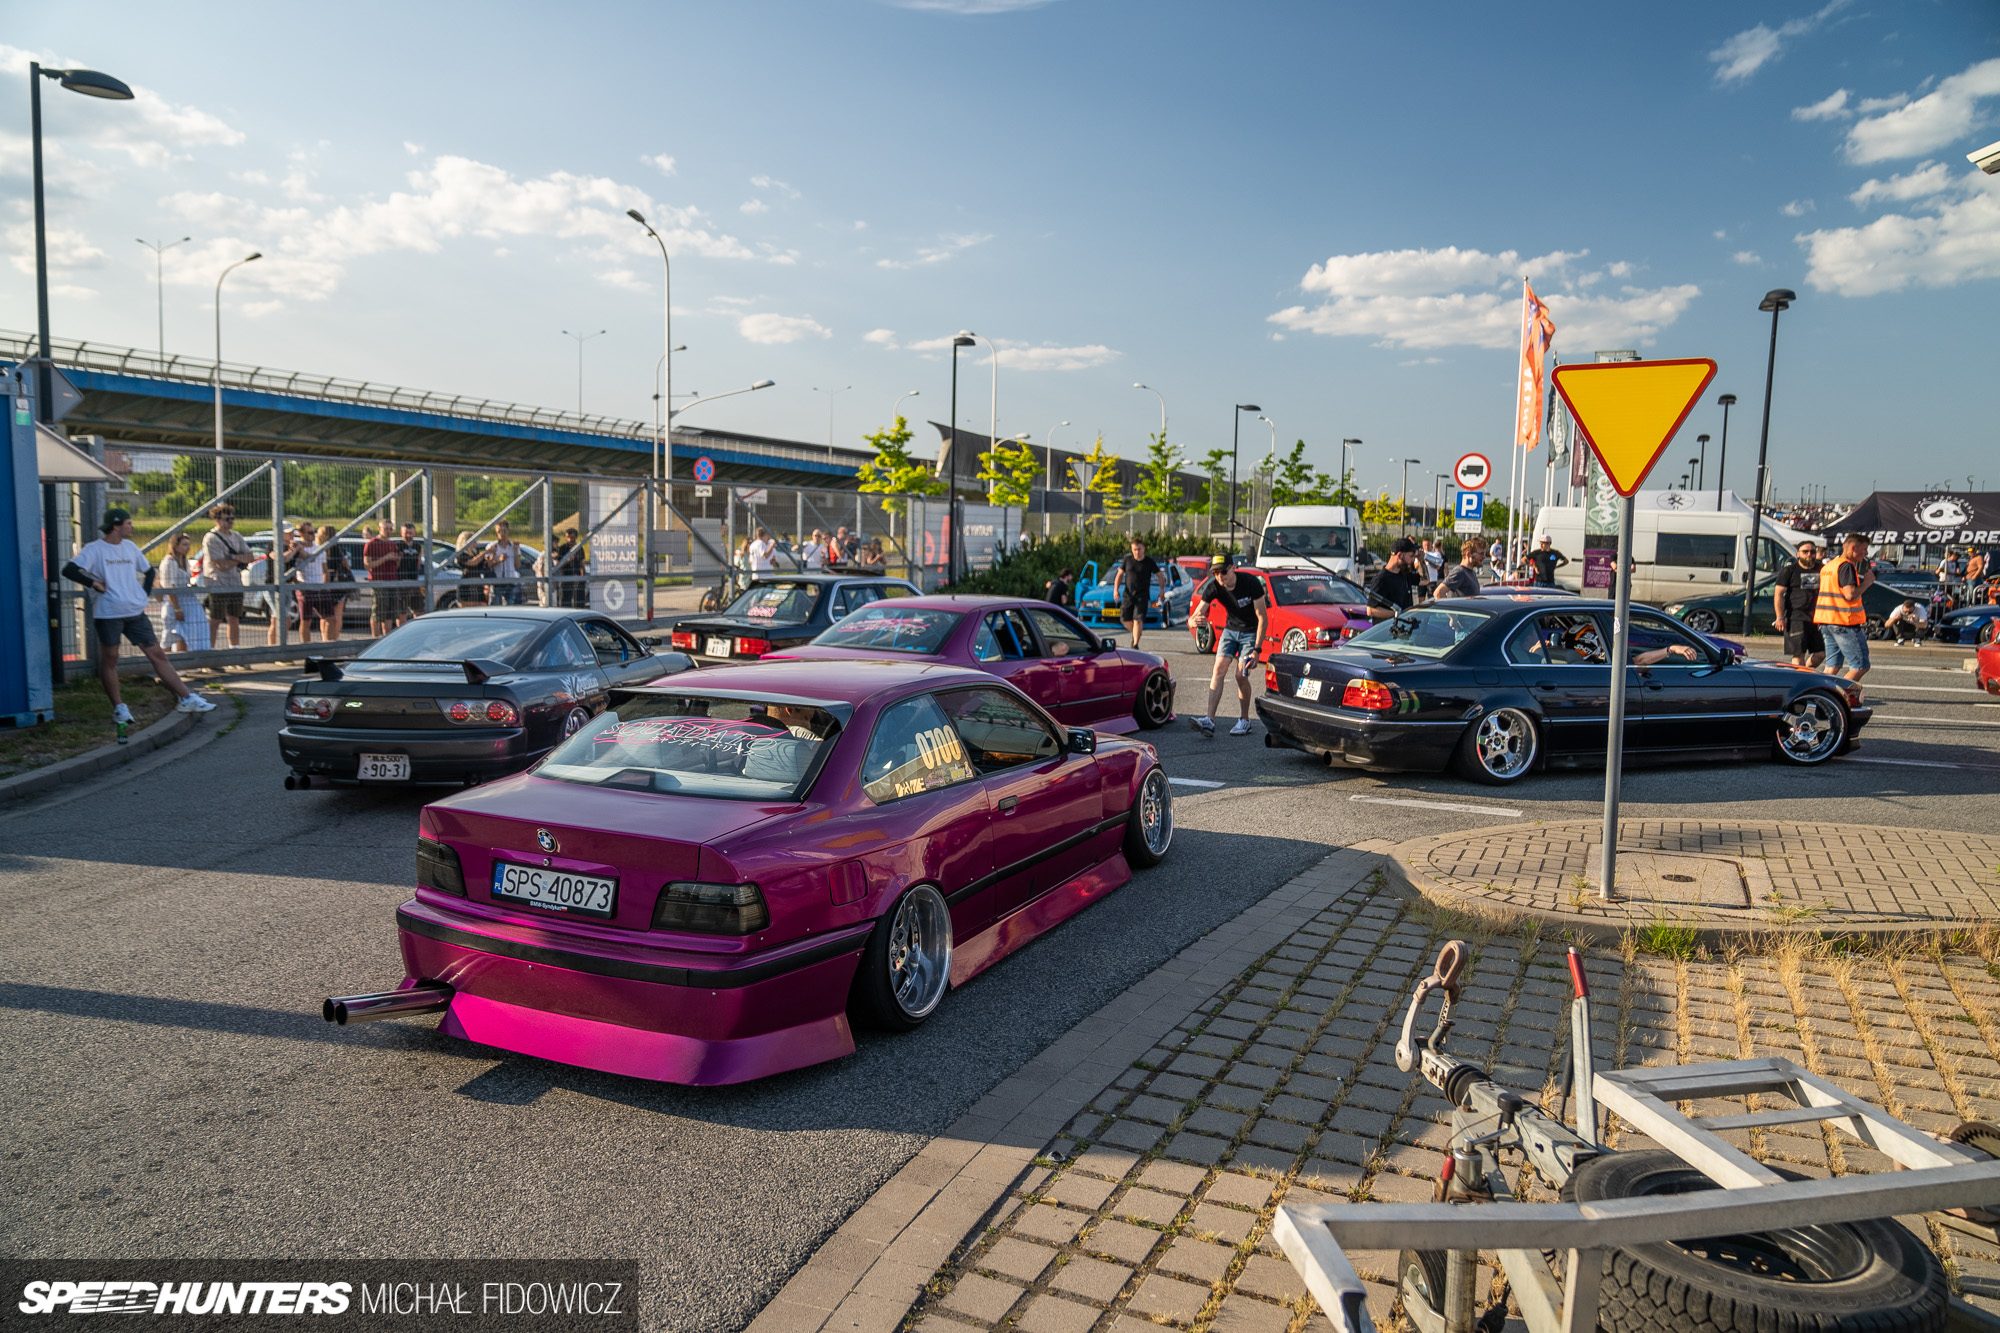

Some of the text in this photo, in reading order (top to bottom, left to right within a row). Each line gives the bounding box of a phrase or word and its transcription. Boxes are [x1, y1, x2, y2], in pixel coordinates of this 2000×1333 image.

[1461, 494, 1478, 517] P
[1902, 530, 1955, 544] STOP
[1959, 530, 2000, 544] DRE
[915, 725, 961, 770] 0700
[370, 763, 406, 777] 90-31
[494, 882, 502, 891] PL
[504, 868, 611, 909] SPS 40873
